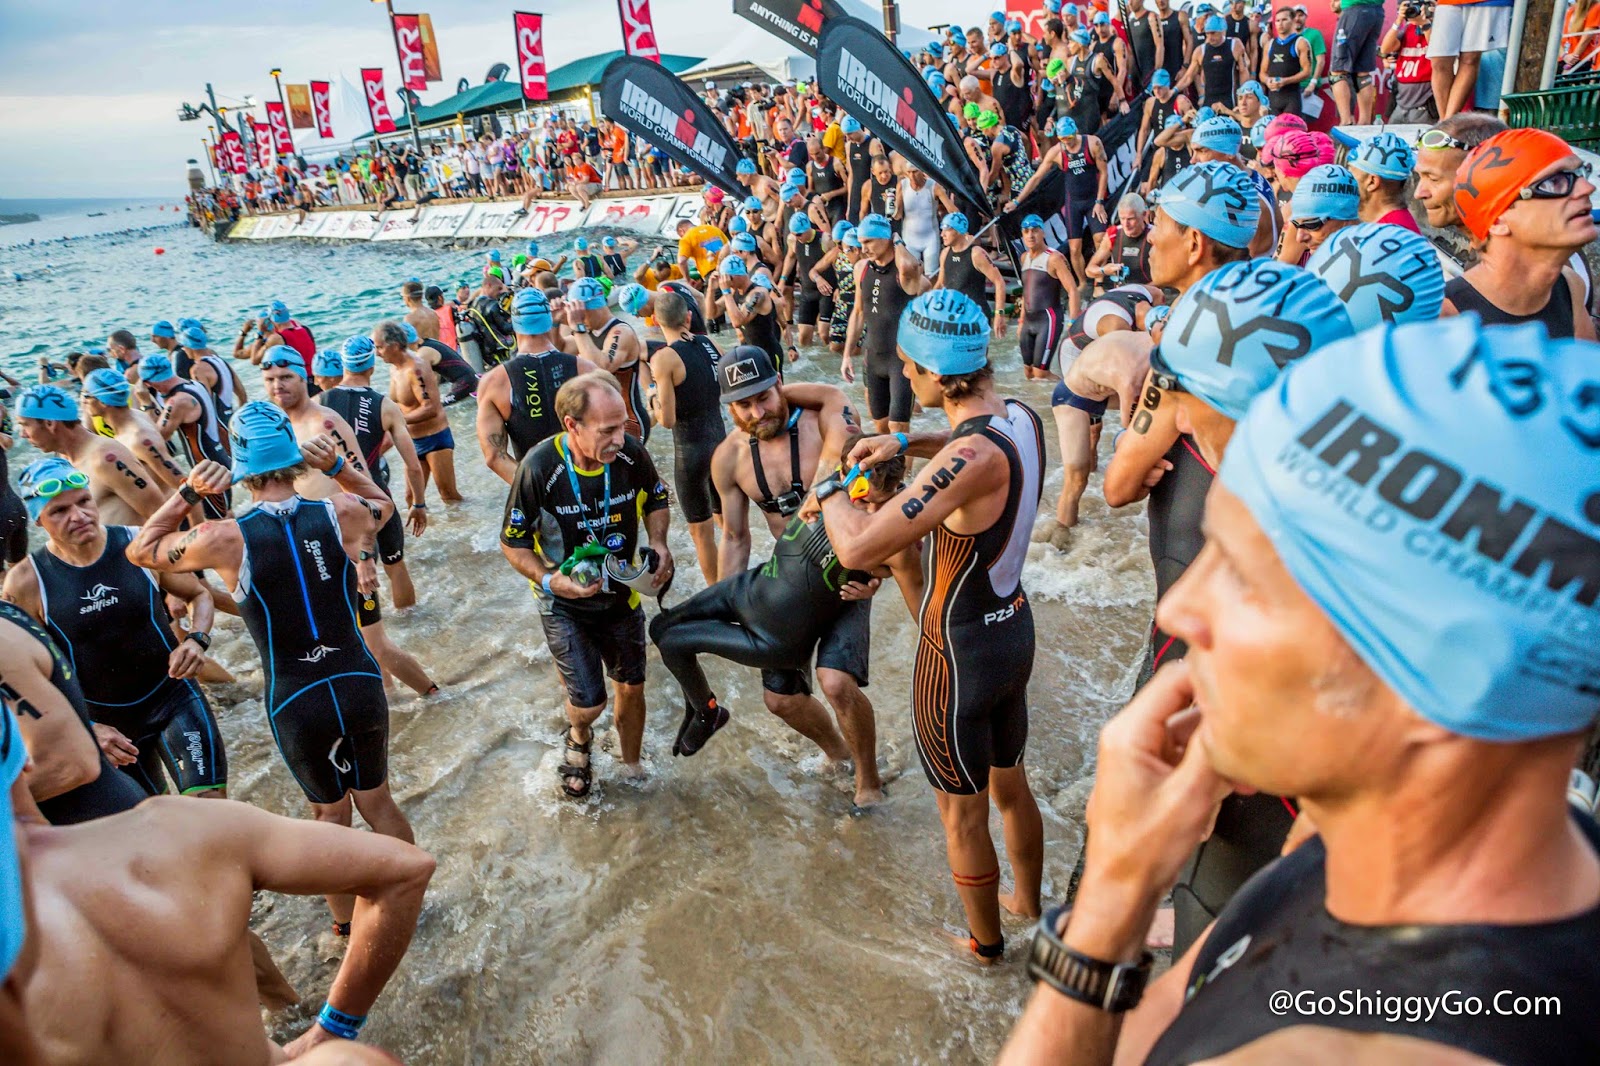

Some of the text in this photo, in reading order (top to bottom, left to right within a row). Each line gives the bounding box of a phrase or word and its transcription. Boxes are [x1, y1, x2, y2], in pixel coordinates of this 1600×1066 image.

[750, 2, 800, 37] ANYTHING
[797, 31, 811, 43] IS
[398, 26, 425, 84] TYR
[519, 27, 546, 90] TYR
[313, 91, 331, 133] TYR
[366, 79, 392, 127] TYR
[837, 76, 874, 114] WORLD
[837, 46, 945, 160] IRONMAN
[269, 110, 292, 149] TYR
[619, 101, 721, 175] WORLD CHAMPIONSHIP
[620, 78, 728, 169] IRONMAN
[256, 130, 270, 167] TYR
[1363, 143, 1408, 168] TYR
[1072, 168, 1086, 176] USA
[1178, 166, 1248, 227] TYR
[525, 206, 571, 233] TYR
[1318, 236, 1415, 325] TYR
[909, 311, 981, 336] IRONMAN
[1178, 289, 1312, 371] TYR
[23, 393, 67, 409] TYR
[901, 457, 968, 520] 1518
[309, 539, 332, 582] pewag
[607, 538, 622, 548] CAF
[79, 595, 119, 615] sailfish
